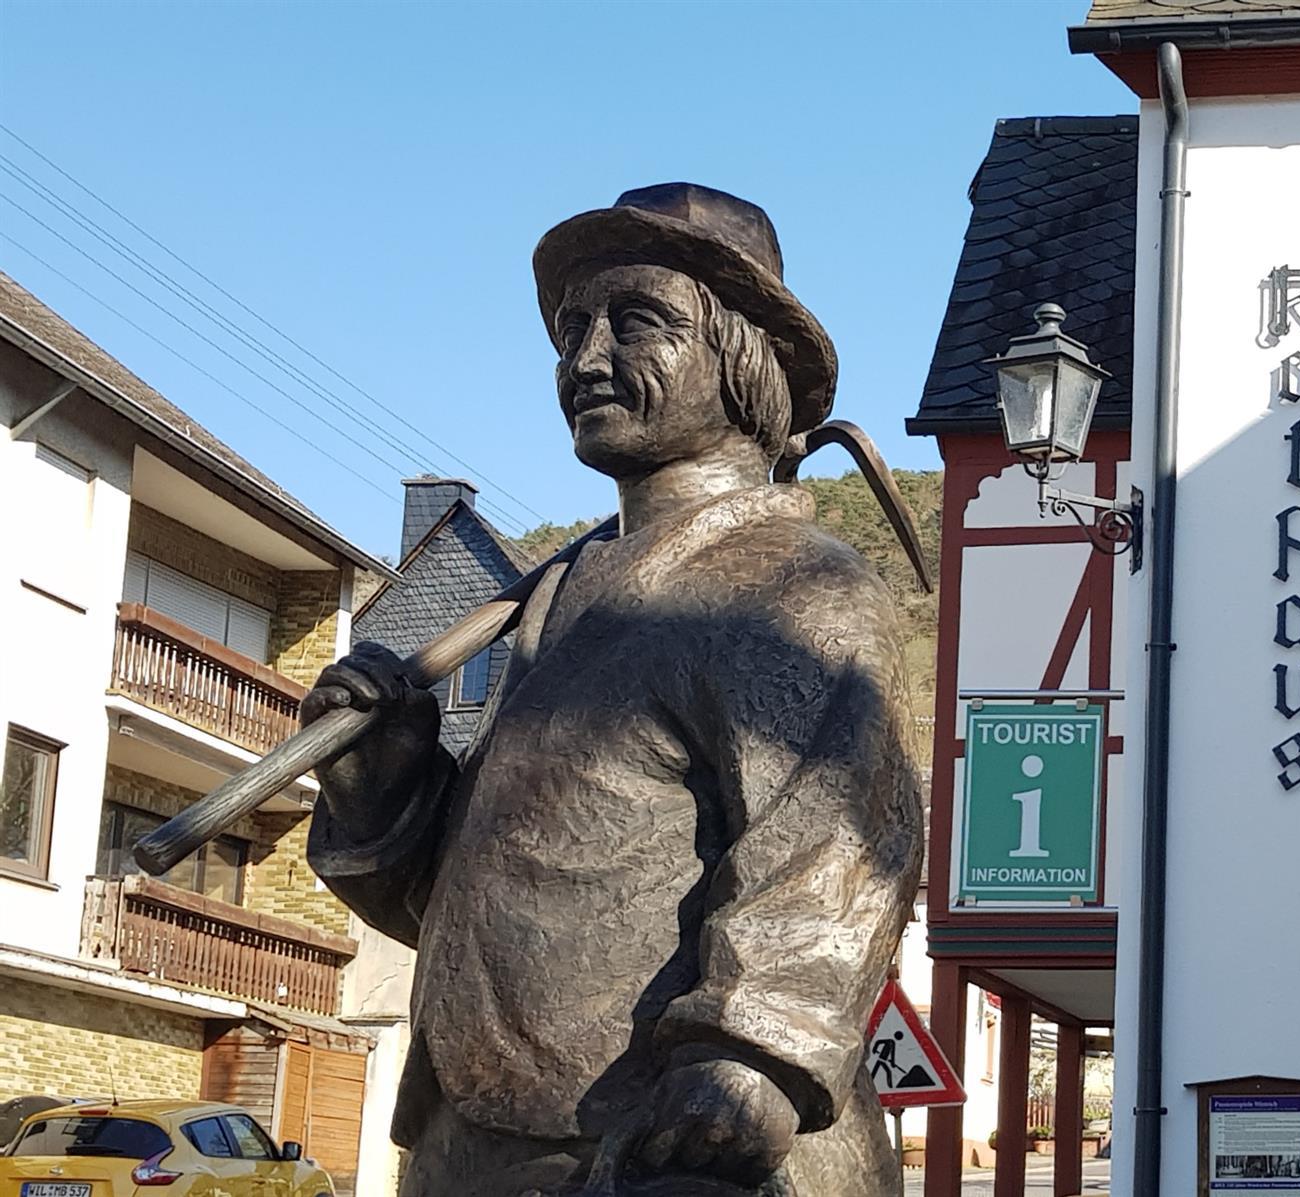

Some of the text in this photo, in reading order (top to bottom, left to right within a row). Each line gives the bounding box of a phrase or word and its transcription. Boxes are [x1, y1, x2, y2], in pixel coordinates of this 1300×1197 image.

[977, 723, 1092, 745] TOURIST
[971, 868, 1086, 882] INFORMATION
[29, 1185, 47, 1197] WIL
[69, 1186, 89, 1197] 537
